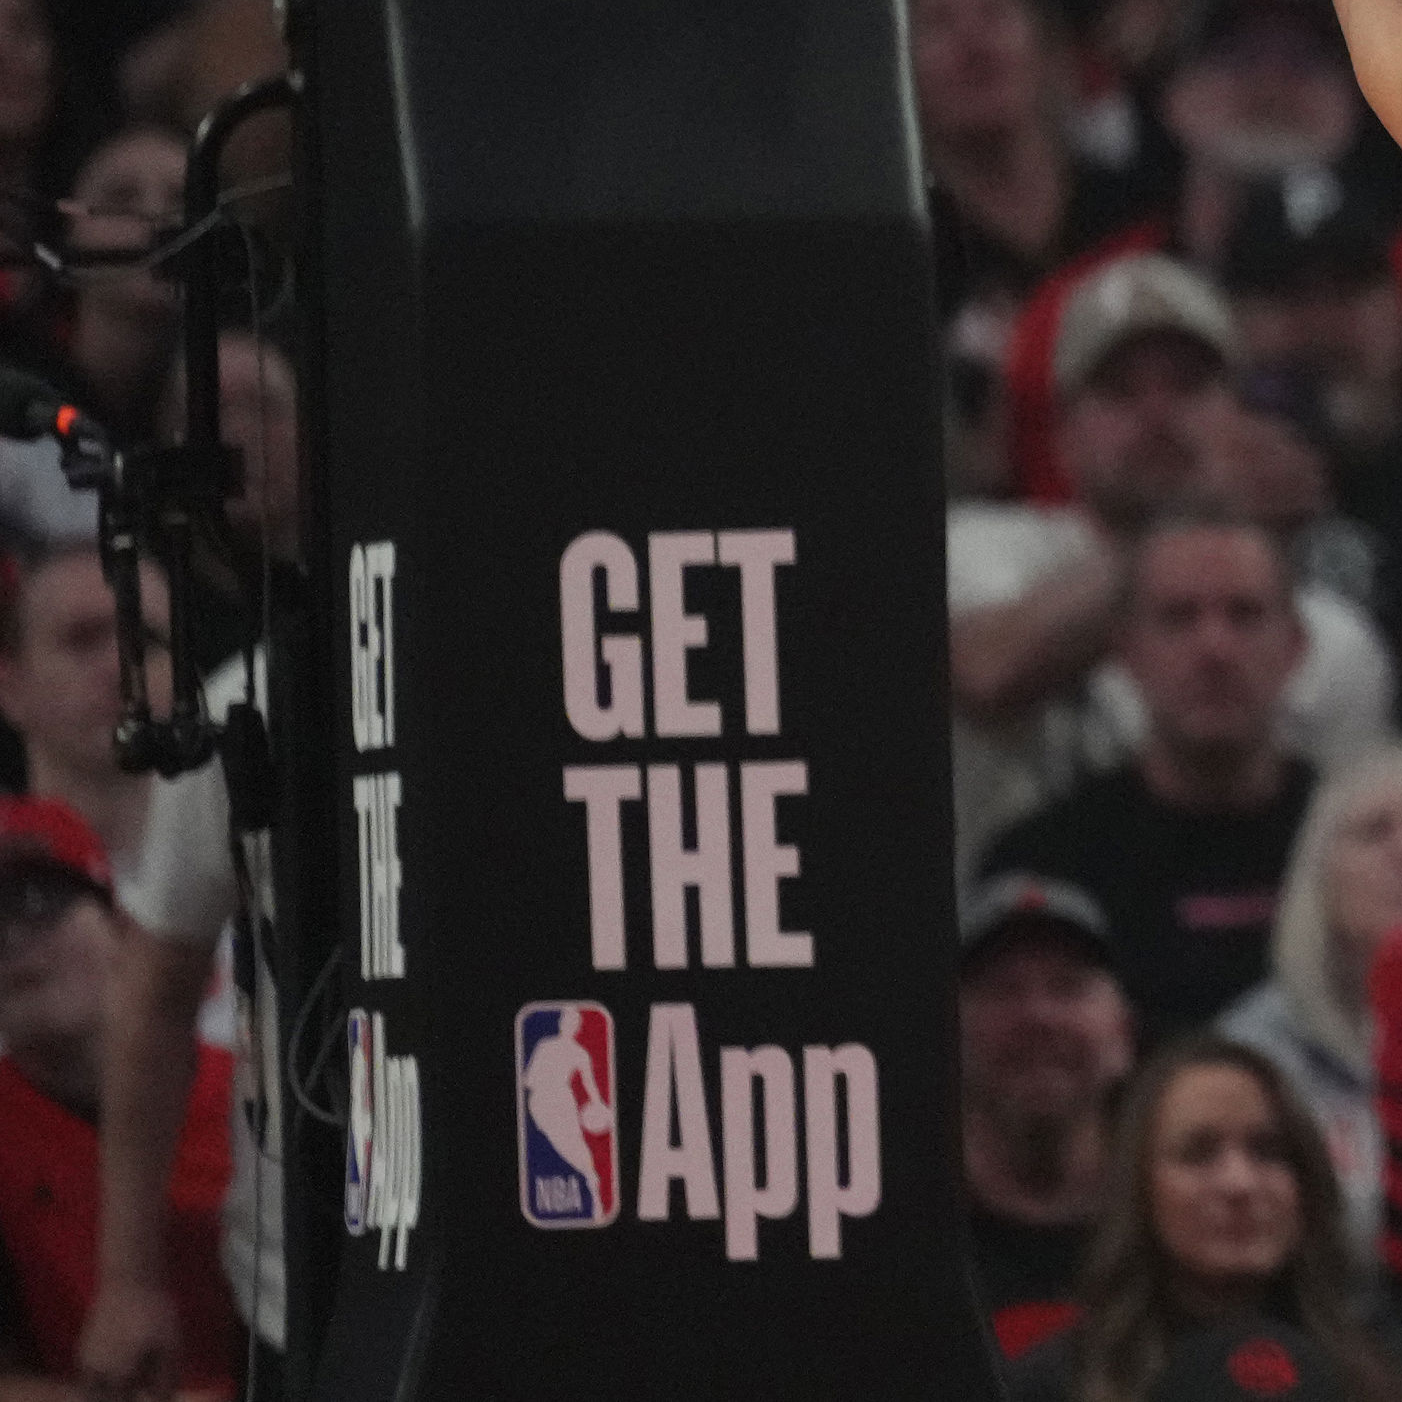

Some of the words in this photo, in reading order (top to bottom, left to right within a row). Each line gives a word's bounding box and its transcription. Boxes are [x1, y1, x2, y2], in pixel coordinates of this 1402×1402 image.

[559, 530, 797, 742] GET
[563, 760, 815, 971] THE
[535, 1174, 583, 1213] NBA
[637, 1002, 883, 1261] App
